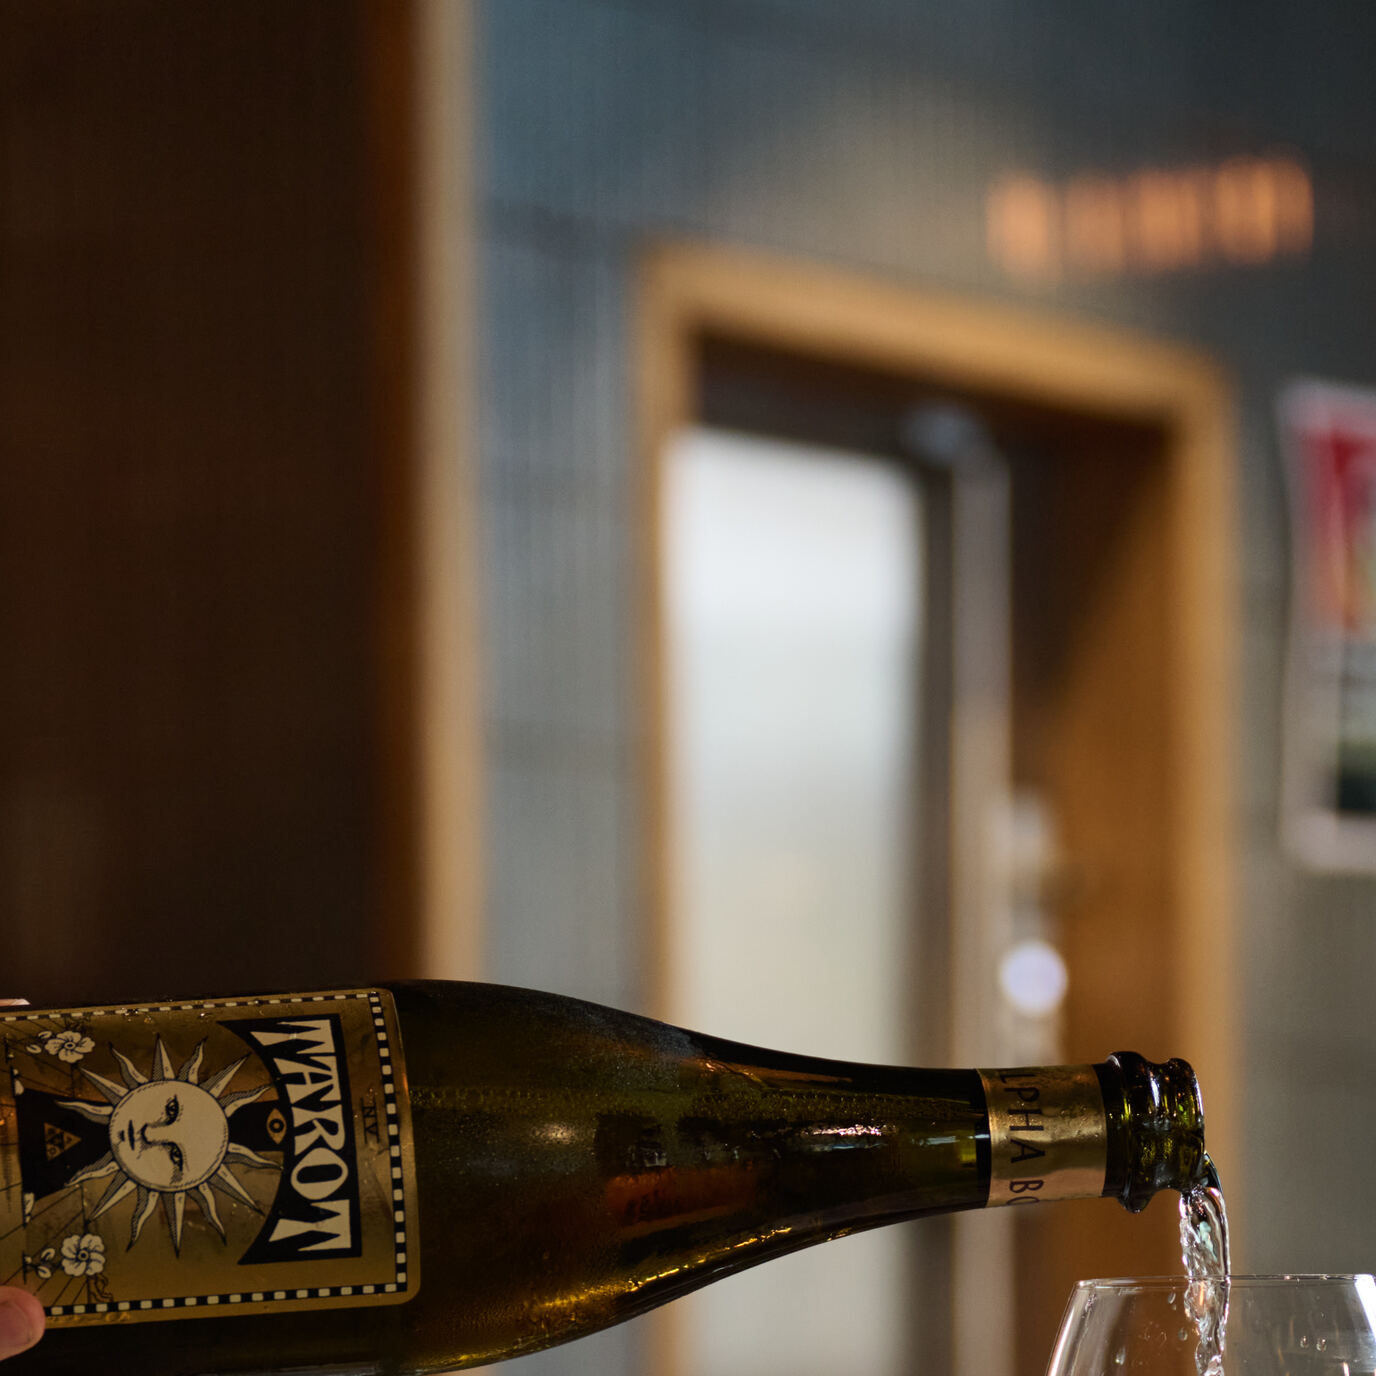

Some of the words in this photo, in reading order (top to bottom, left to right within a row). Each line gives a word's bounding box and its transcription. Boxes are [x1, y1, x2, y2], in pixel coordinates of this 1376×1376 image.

[249, 1018, 352, 1252] TAROT
[999, 1071, 1046, 1164] LPHA
[1006, 1179, 1044, 1206] BO
